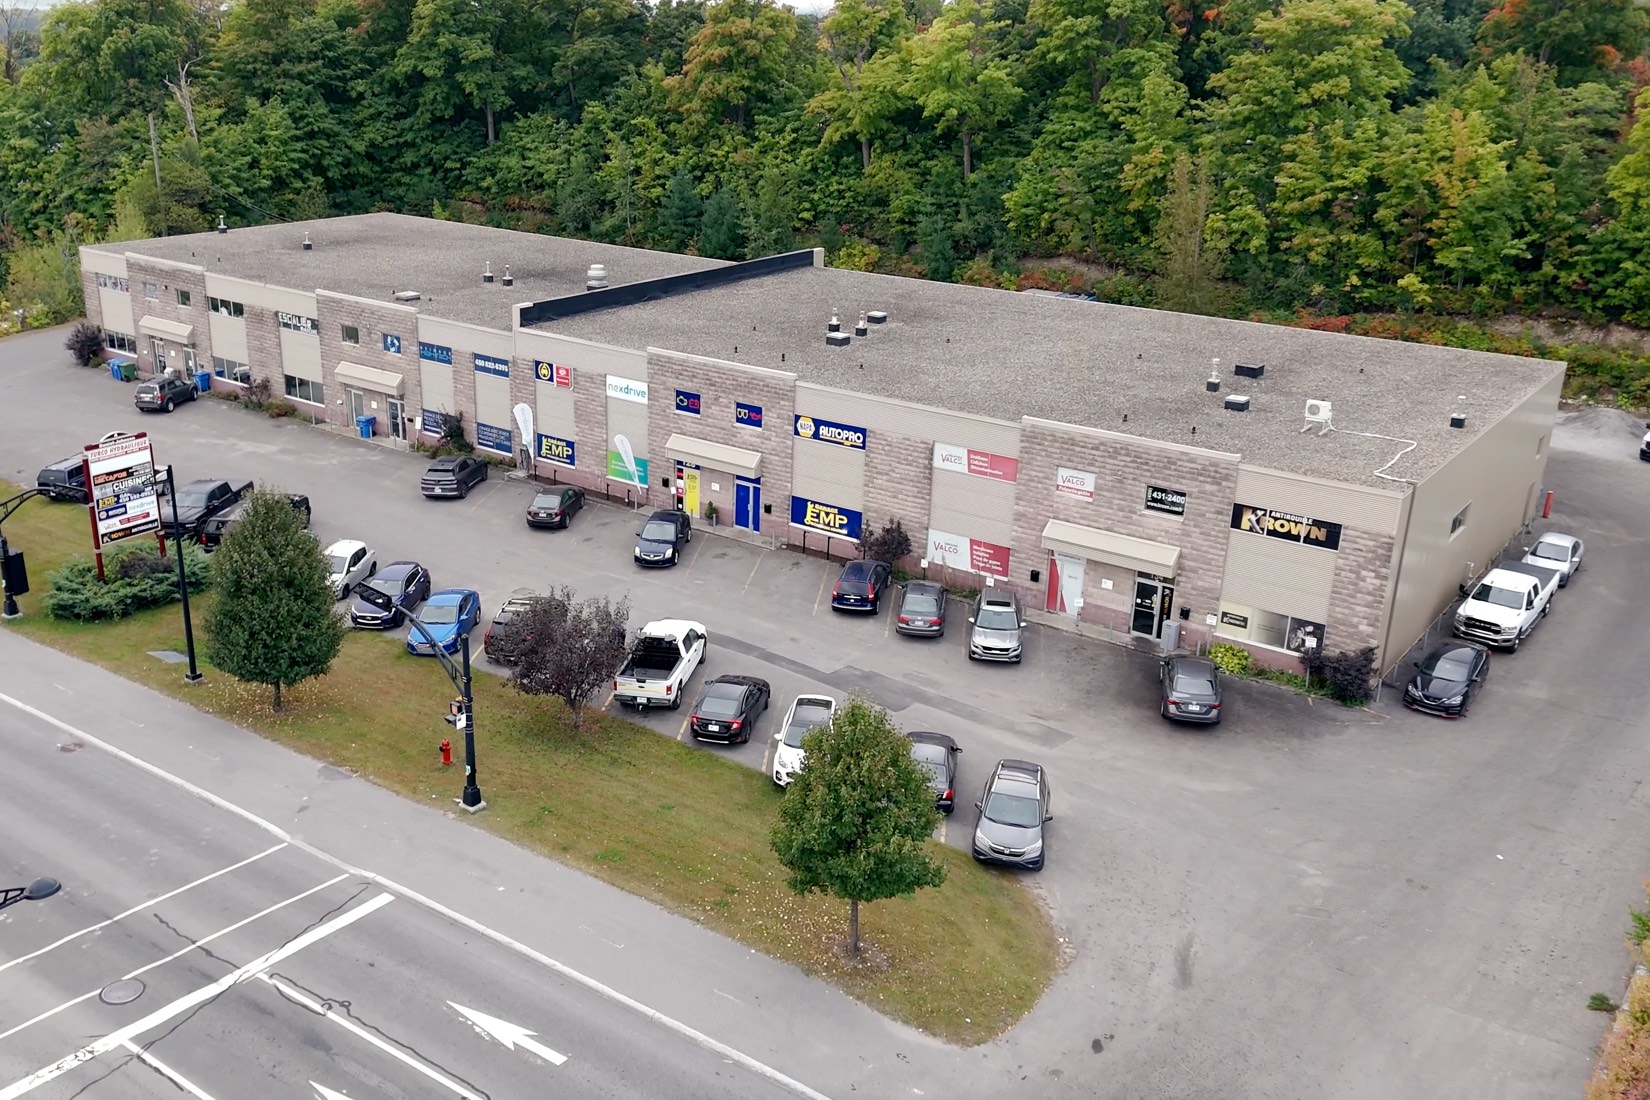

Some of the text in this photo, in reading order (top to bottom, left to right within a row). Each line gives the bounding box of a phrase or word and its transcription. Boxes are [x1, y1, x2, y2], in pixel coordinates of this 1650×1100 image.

[608, 383, 646, 398] nexdrive
[800, 422, 863, 443] NAPA AUTOPRO
[90, 449, 108, 459] TURCO
[110, 440, 147, 453] HYDRAULIQUE
[541, 440, 572, 458] EMP
[941, 453, 963, 465] VALCO
[1061, 475, 1085, 486] VALCO
[1152, 491, 1185, 504] 431-2400
[804, 505, 848, 528] EMP
[1240, 507, 1327, 541] KROWN
[933, 541, 959, 555] VALCO
